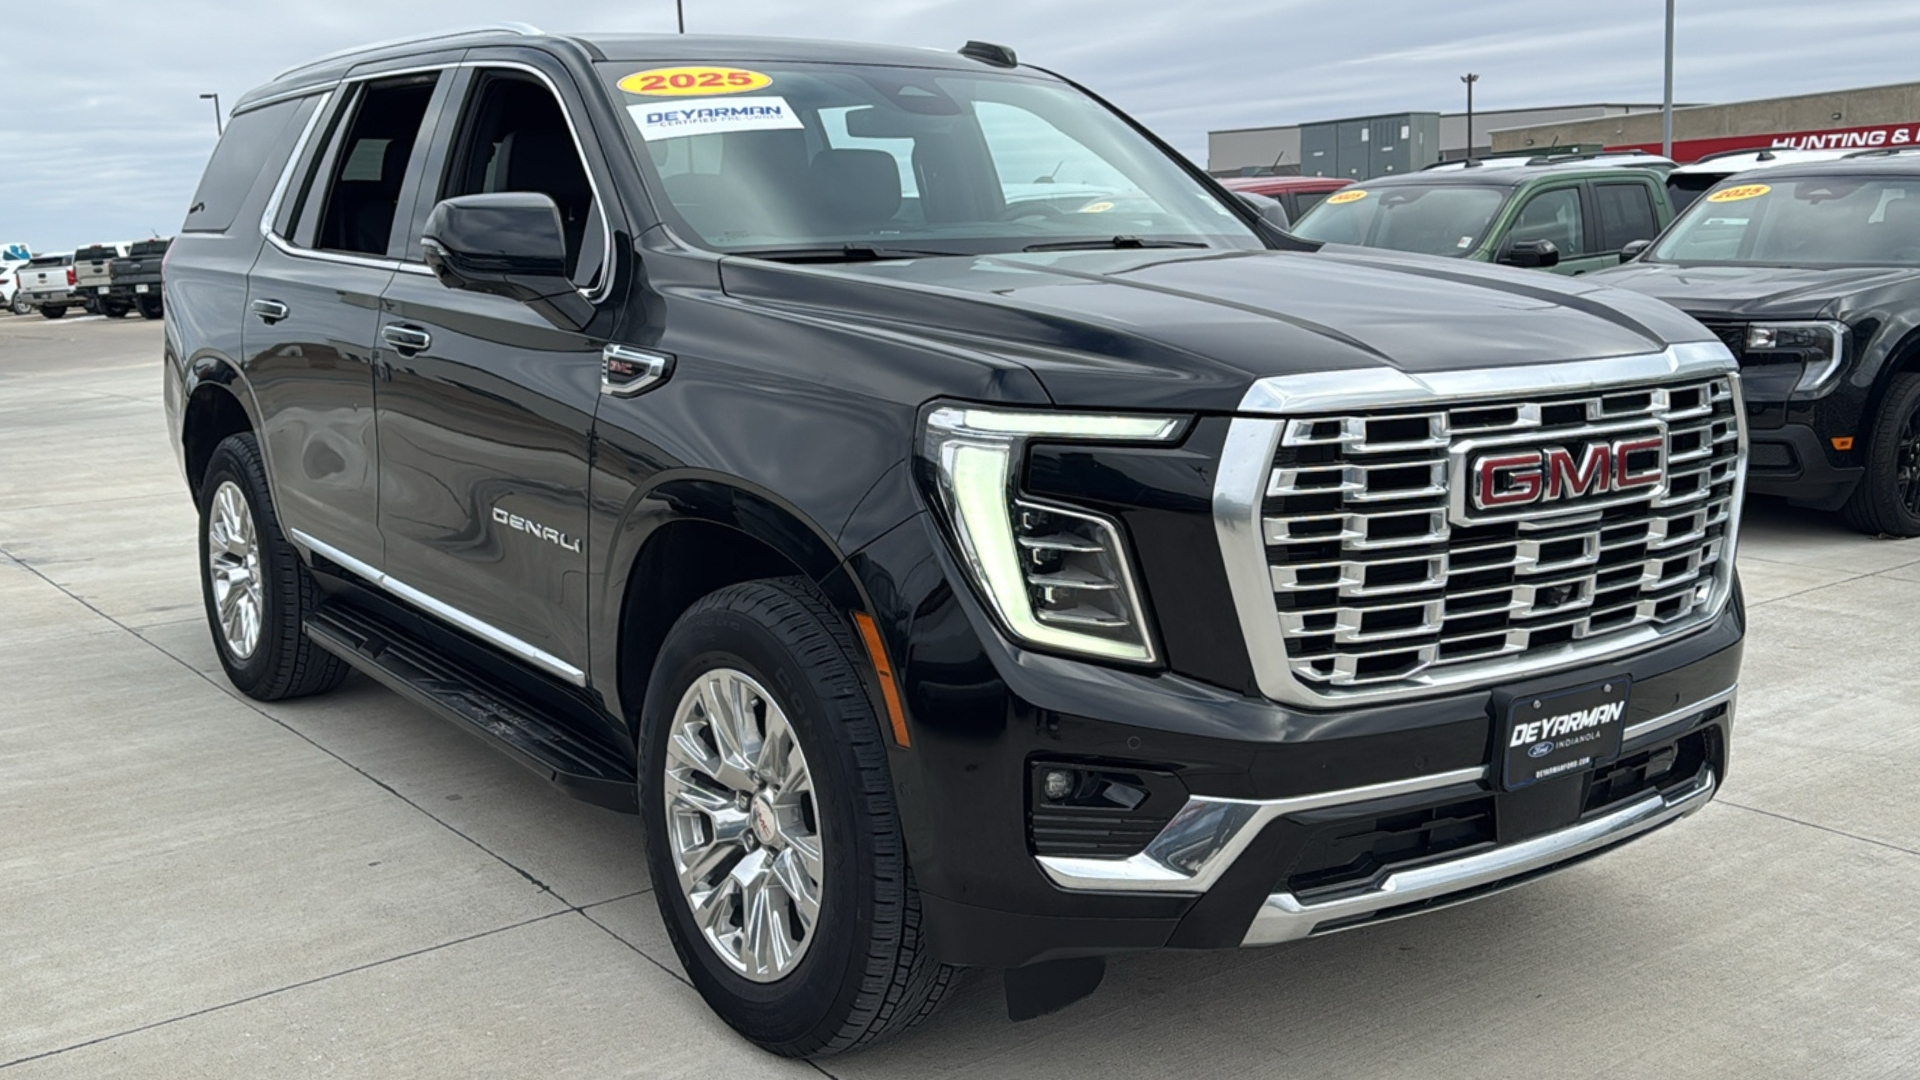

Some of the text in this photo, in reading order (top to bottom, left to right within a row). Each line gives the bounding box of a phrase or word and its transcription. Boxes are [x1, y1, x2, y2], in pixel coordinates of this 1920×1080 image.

[640, 72, 753, 91] 2025
[646, 105, 781, 124] DEYARMAN
[660, 116, 718, 127] CERTIFIED
[1771, 131, 1887, 151] HUNTING
[1891, 128, 1910, 144] &
[1712, 186, 1765, 200] 2025
[1474, 436, 1663, 510] GMC
[492, 506, 581, 554] DENALI
[1509, 700, 1625, 748] DEYARMAN
[1555, 730, 1601, 749] INDIANOLA
